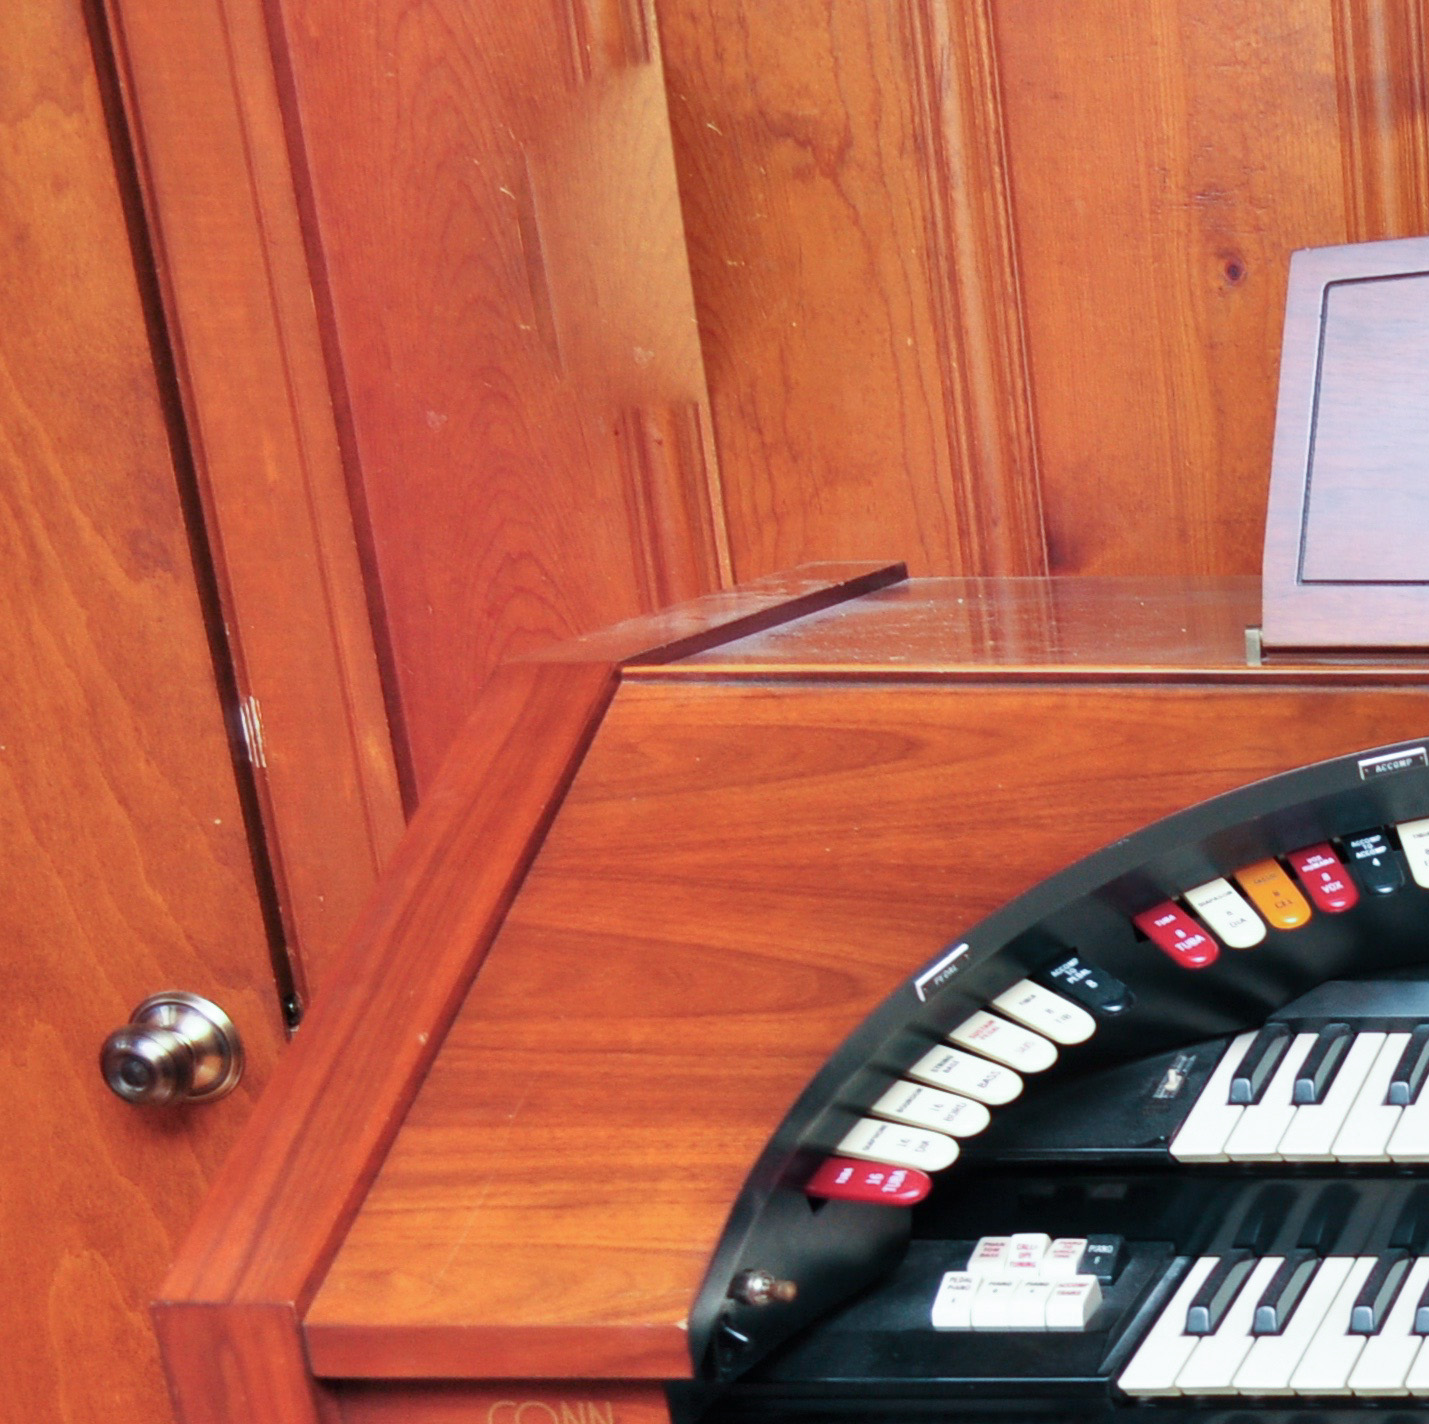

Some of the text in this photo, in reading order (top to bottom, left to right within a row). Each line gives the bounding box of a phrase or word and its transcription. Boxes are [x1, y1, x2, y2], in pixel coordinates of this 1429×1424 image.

[1375, 758, 1413, 773] ACCOMP
[1351, 835, 1381, 847] ACCOMP
[1355, 846, 1386, 859] ACCOMP
[1372, 857, 1381, 866] 4
[1321, 881, 1344, 894] VOX
[1154, 914, 1176, 927] TUBA
[1174, 934, 1205, 951] TUBA
[1051, 958, 1079, 977] ACCOMP
[978, 1071, 1001, 1088] BASS
[866, 1173, 884, 1184] 16
[882, 1170, 908, 1192] TUBA
